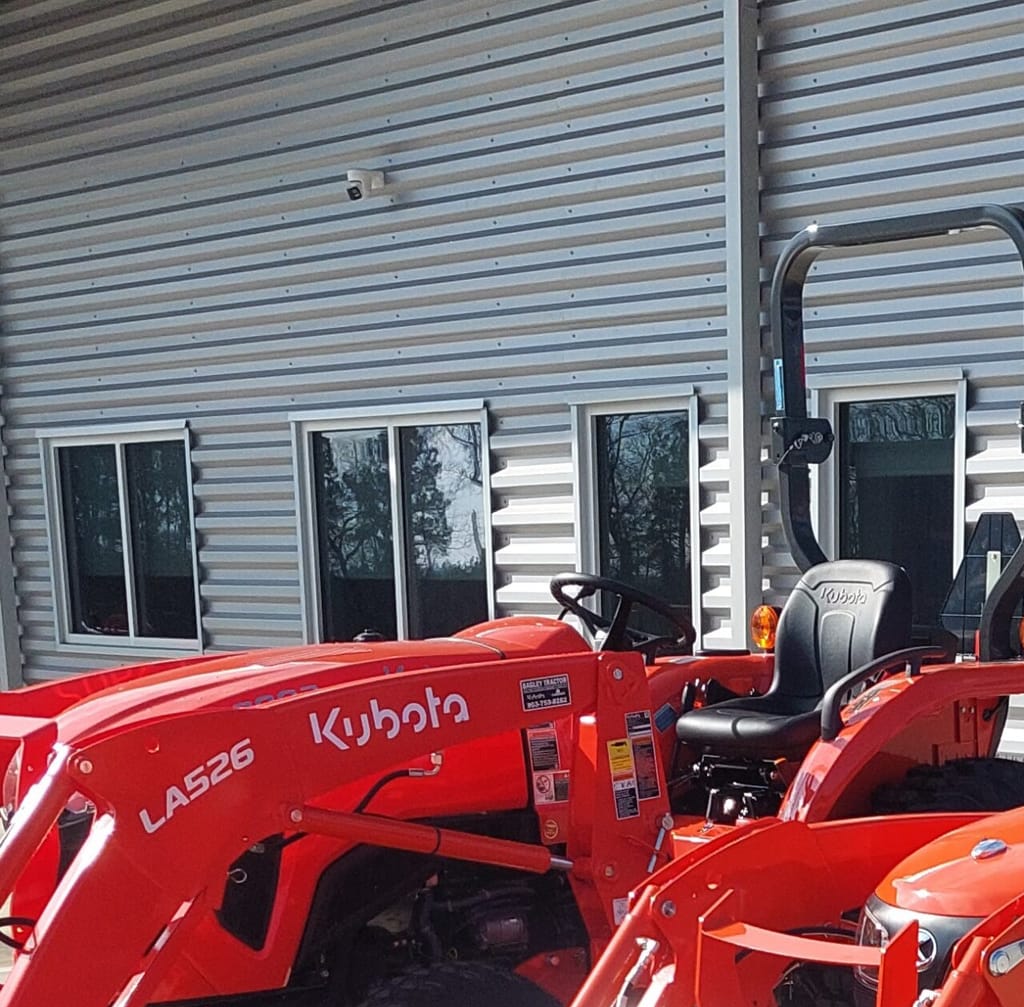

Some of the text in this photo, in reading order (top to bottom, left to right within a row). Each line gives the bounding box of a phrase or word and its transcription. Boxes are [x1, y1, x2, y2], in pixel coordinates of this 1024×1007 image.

[820, 586, 868, 605] Kubota
[309, 687, 470, 750] Kubota
[138, 738, 255, 834] LA526
